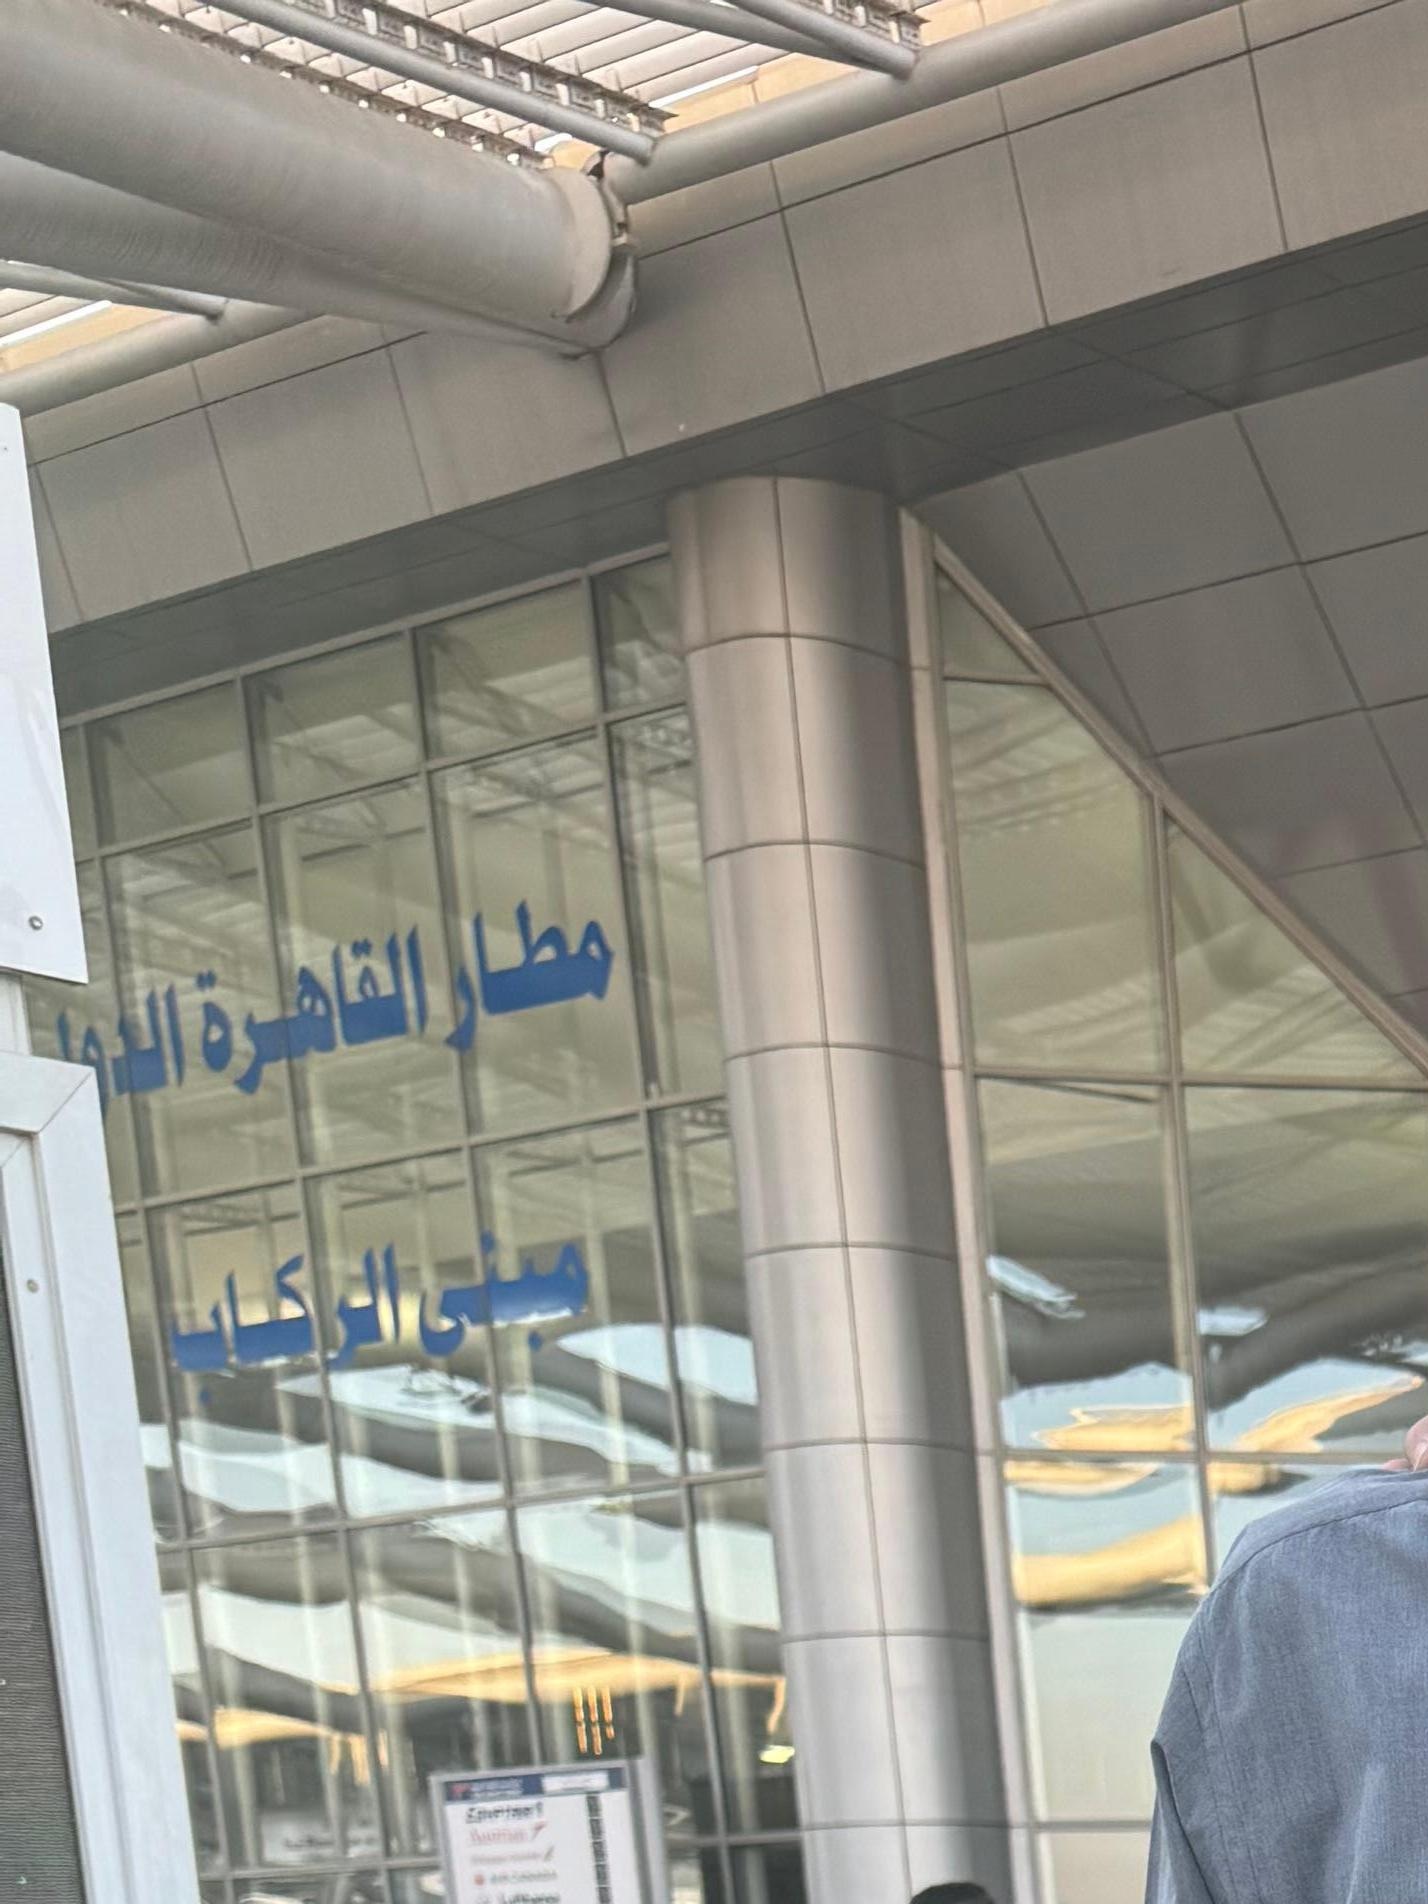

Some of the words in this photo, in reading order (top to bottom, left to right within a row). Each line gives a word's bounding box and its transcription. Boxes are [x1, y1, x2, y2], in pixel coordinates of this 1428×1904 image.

[57, 982, 186, 1120] الدو
[195, 925, 429, 1096] القاهرة
[444, 900, 615, 1055] مطار
[172, 1242, 400, 1406] الركاب
[419, 1229, 589, 1357] مبنى
